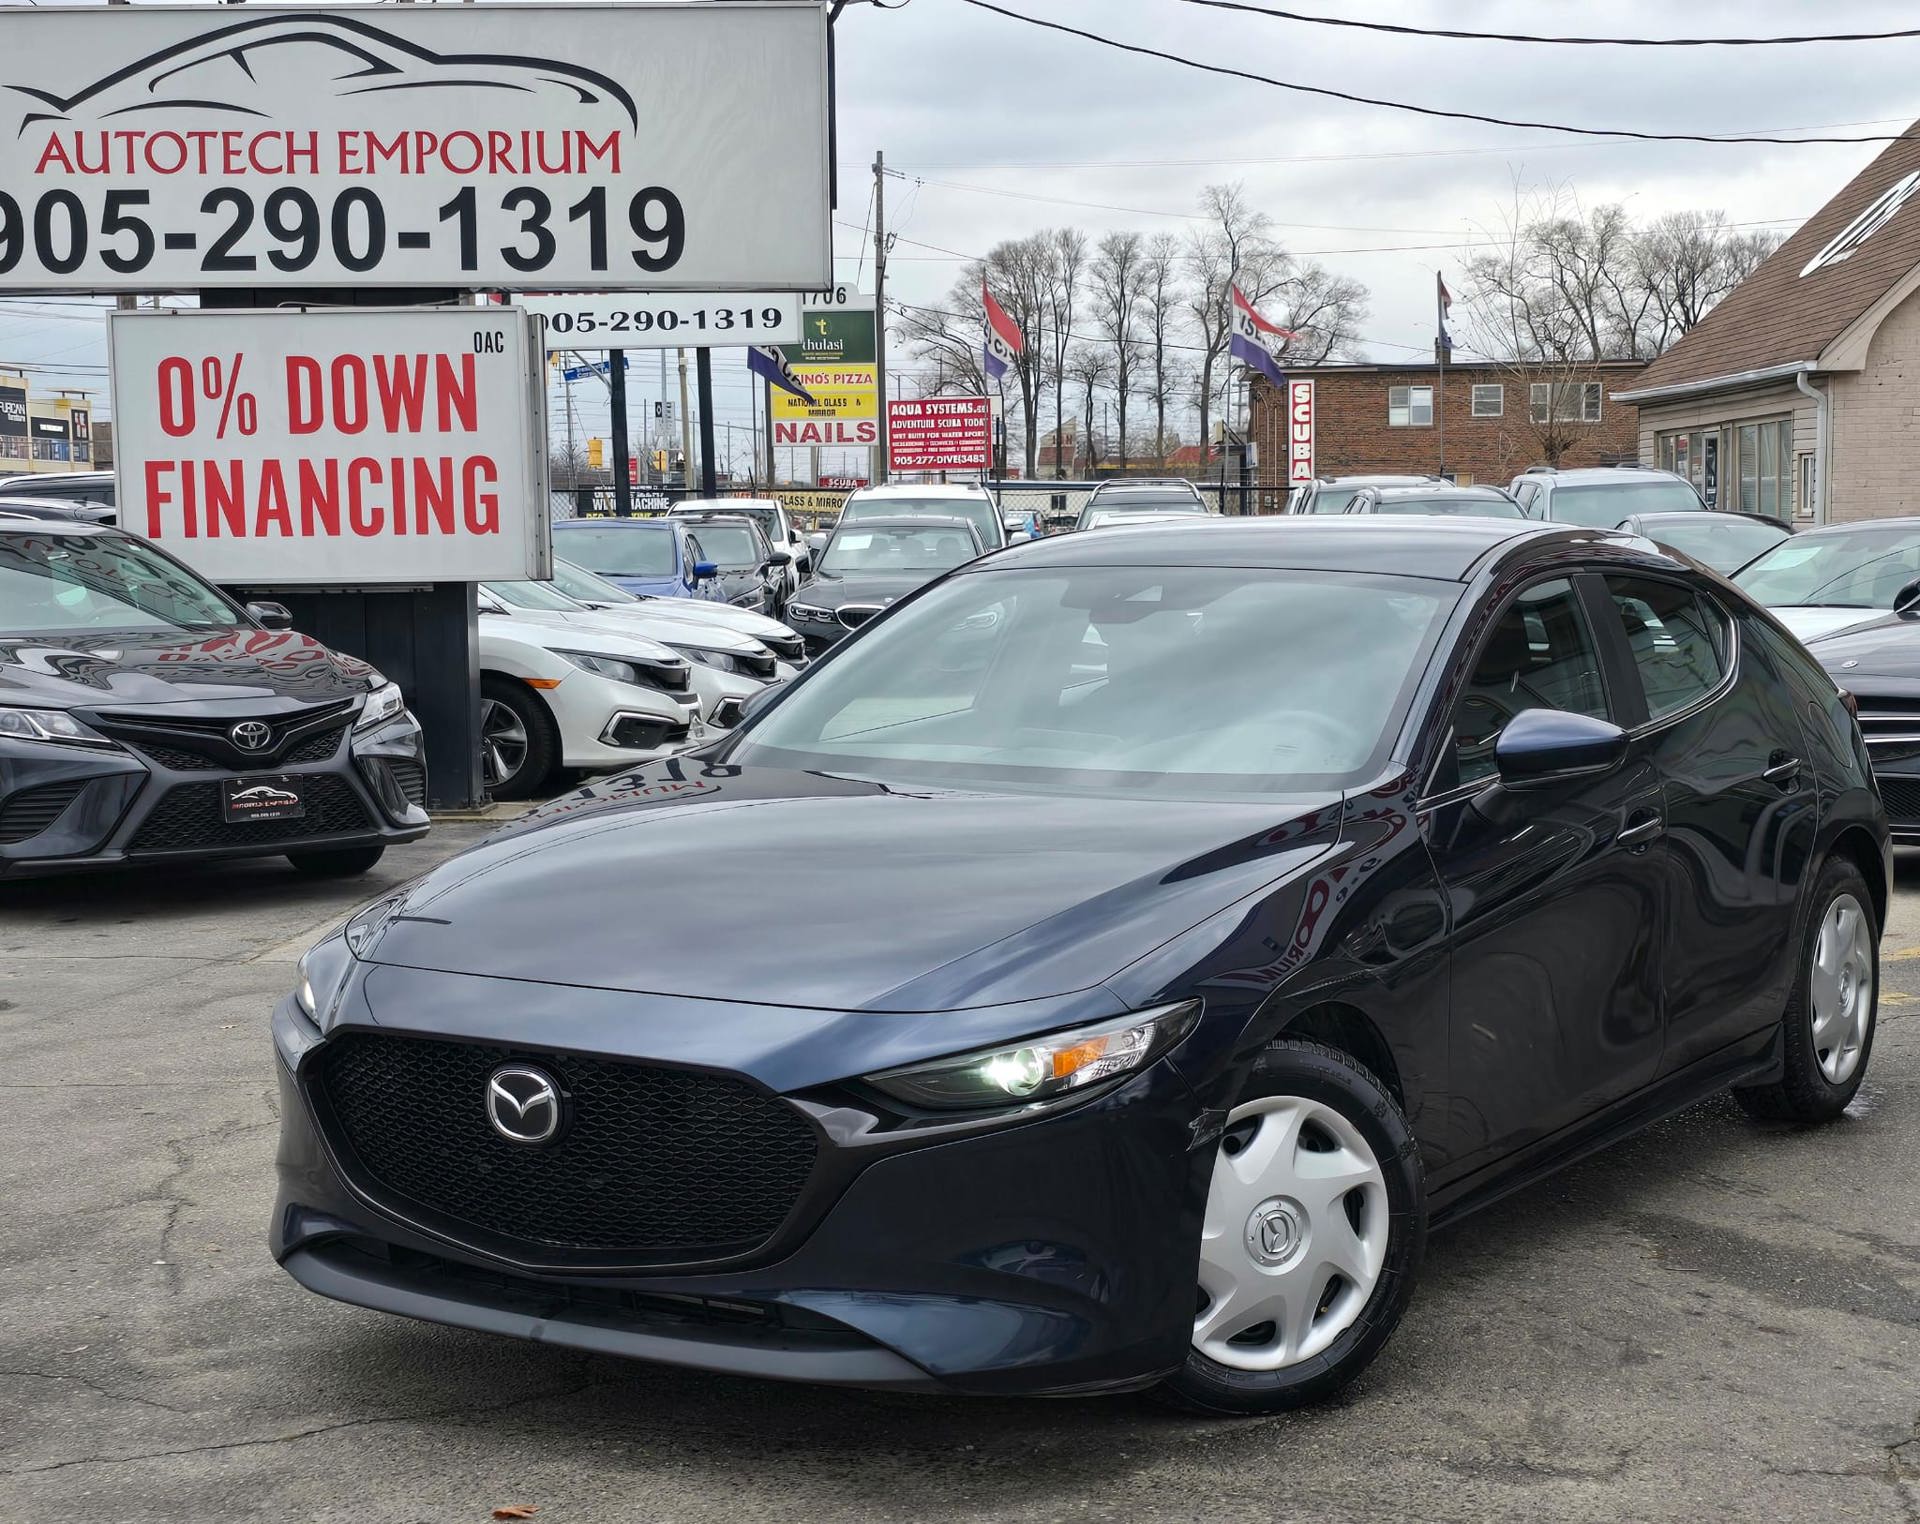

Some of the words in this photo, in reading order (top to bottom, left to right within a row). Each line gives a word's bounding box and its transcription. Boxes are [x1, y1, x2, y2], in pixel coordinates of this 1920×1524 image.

[34, 130, 320, 175] AUTOTECH
[338, 129, 622, 174] EMPORIUM
[473, 331, 504, 353] OAC
[795, 372, 830, 385] INO'S
[833, 373, 873, 385] PIZZA
[157, 352, 258, 439] 0%
[285, 353, 478, 435] DOWN
[787, 397, 822, 407] NATIOL
[824, 398, 847, 407] GLASS
[891, 404, 922, 415] AQUA
[774, 421, 877, 443] NAILS
[938, 419, 961, 428] SCUBA
[1293, 384, 1312, 479] SCUBA
[144, 455, 500, 539] FINANCING
[777, 494, 805, 507] GLASS
